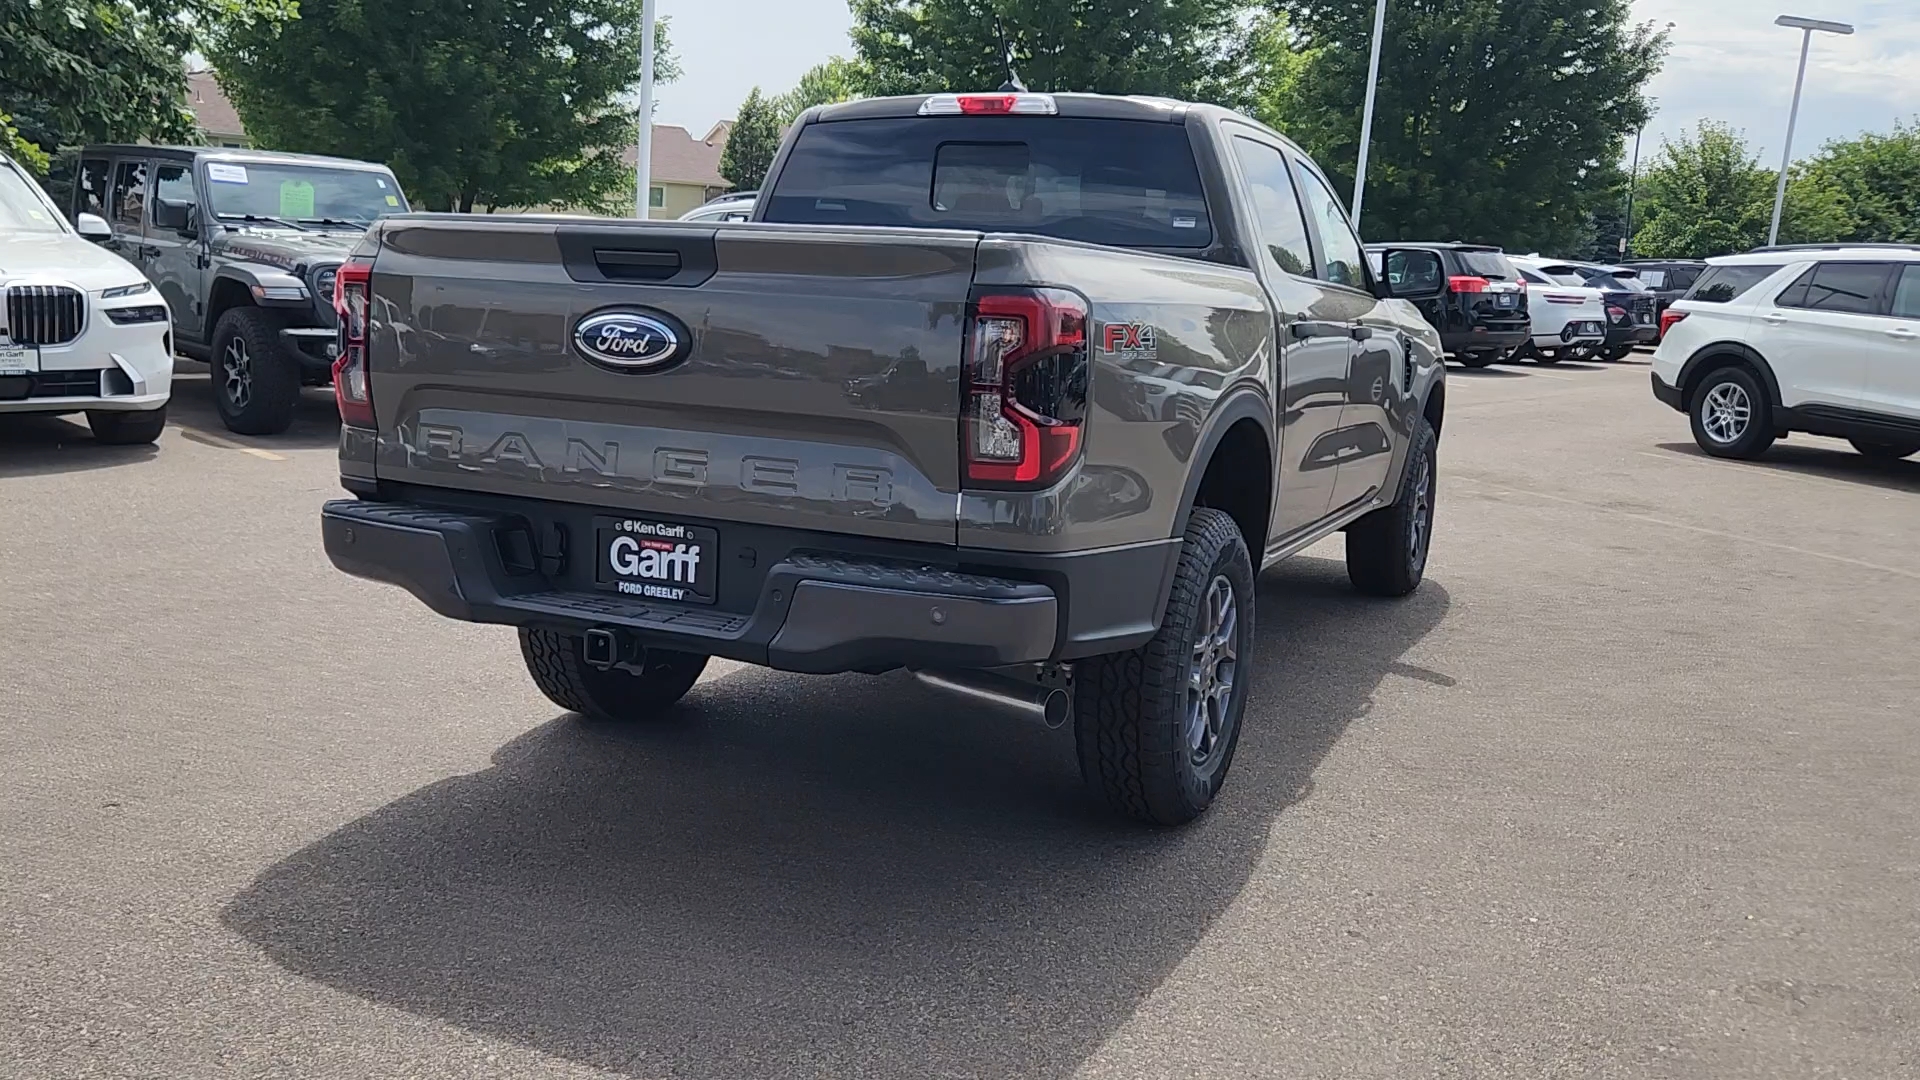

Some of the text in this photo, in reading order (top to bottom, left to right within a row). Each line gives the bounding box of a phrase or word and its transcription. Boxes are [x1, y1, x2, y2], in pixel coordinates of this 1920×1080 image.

[229, 247, 294, 265] RUBICON
[596, 324, 650, 354] Ford
[1103, 322, 1157, 355] FX4
[1121, 350, 1137, 360] OFF
[418, 422, 894, 507] RANGER
[633, 520, 685, 538] Ken Garff
[610, 535, 700, 584] Garff
[618, 582, 685, 601] FORD GREELEY
